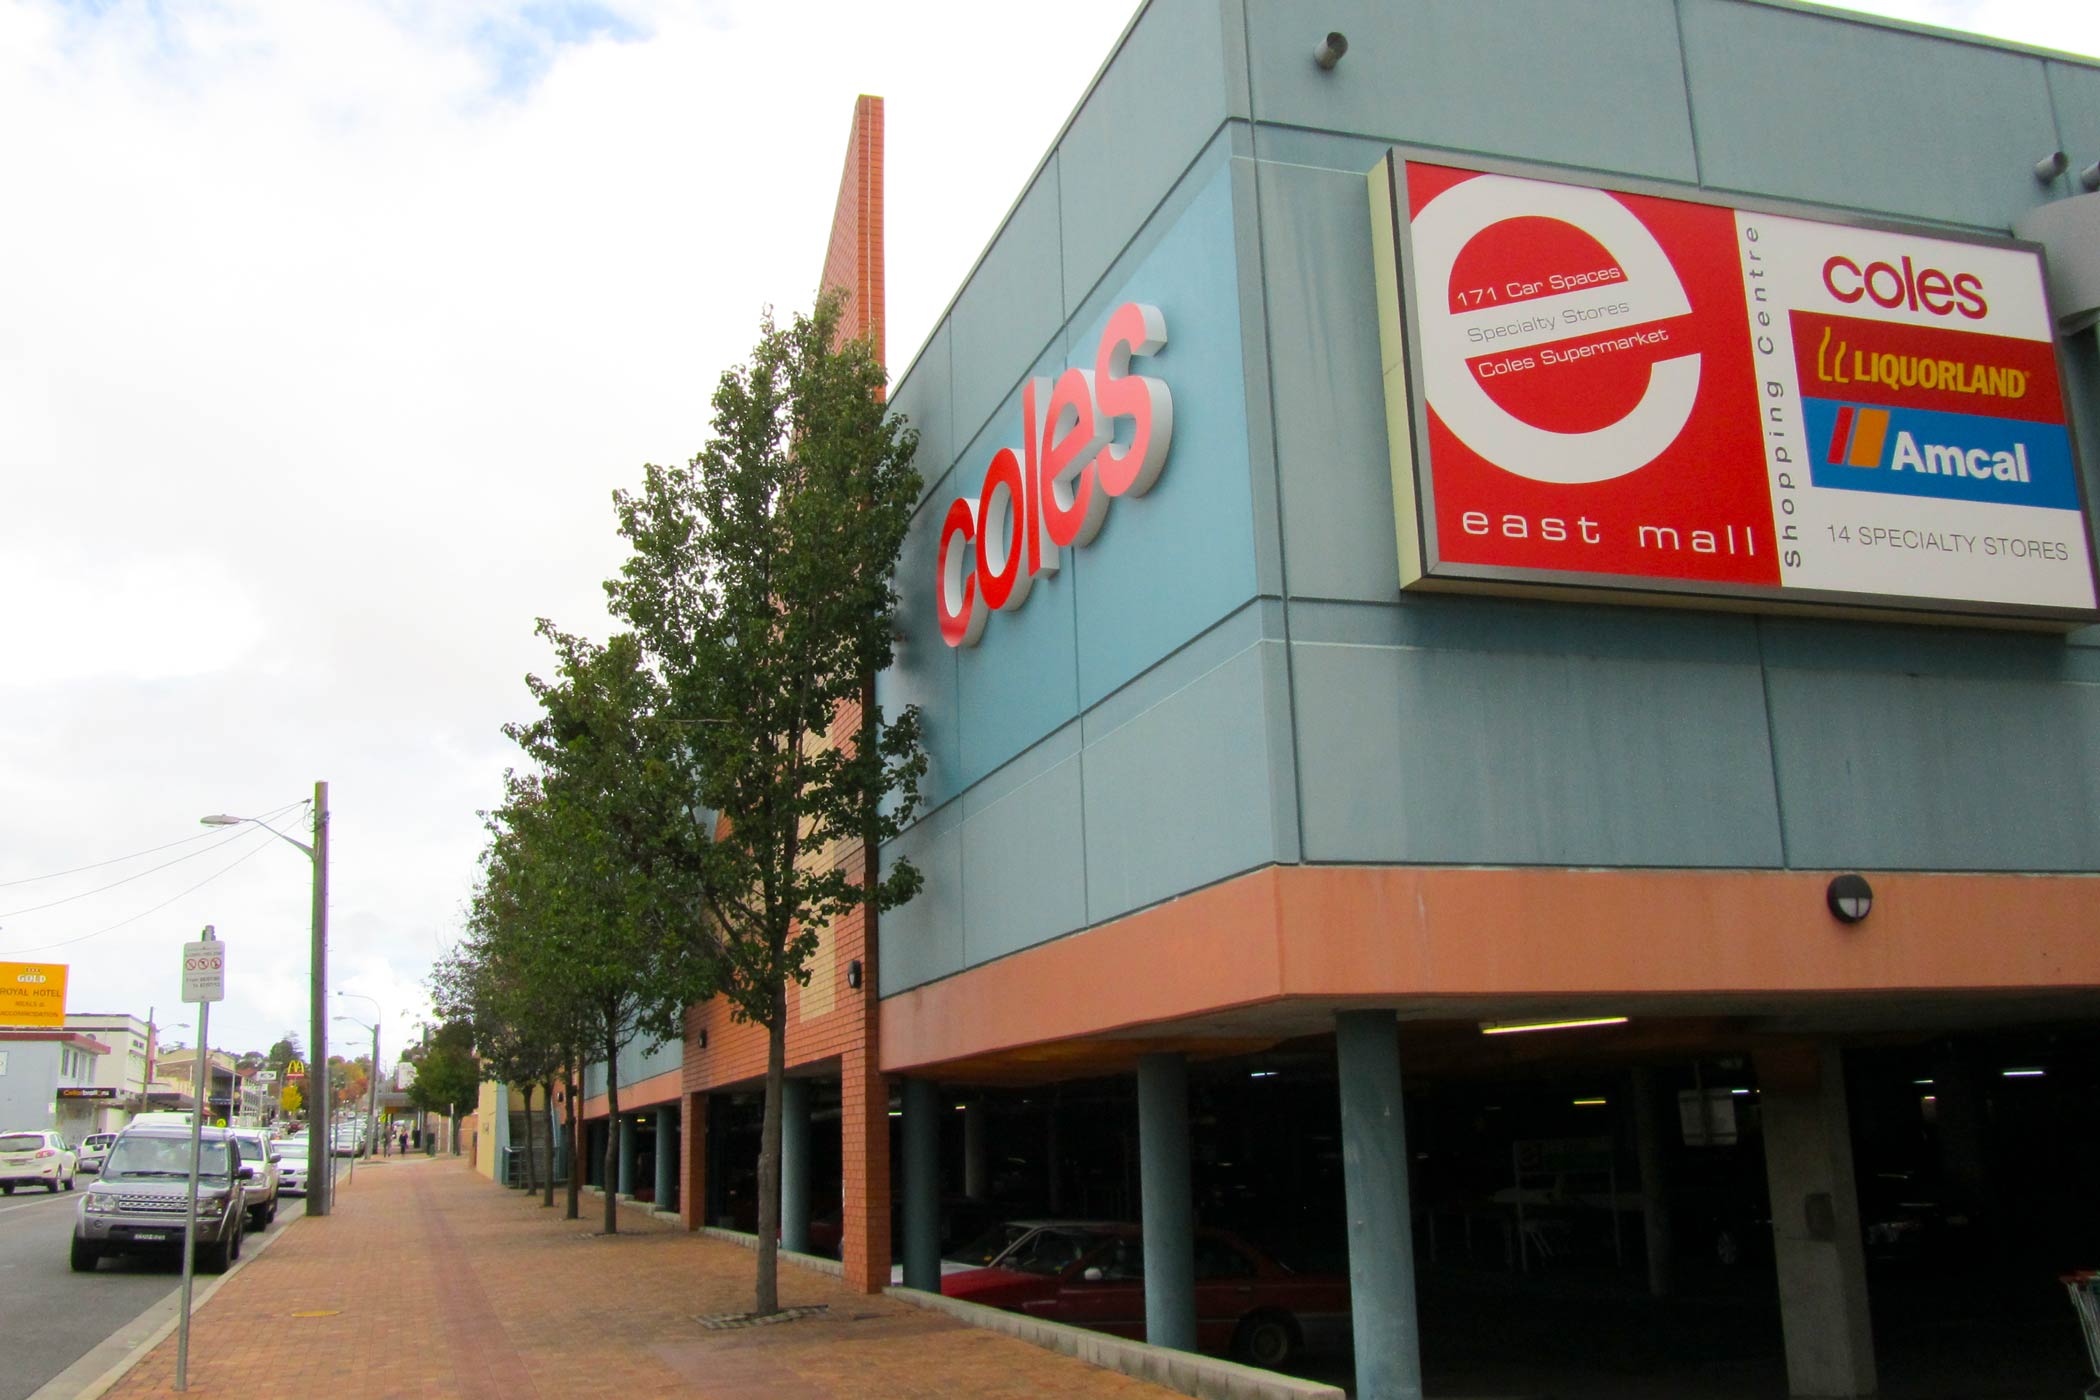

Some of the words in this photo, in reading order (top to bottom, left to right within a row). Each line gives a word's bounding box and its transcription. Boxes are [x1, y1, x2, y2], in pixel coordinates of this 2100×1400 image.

[1456, 286, 1498, 308] 171
[1506, 281, 1544, 298] Car
[1548, 266, 1622, 294] Spaces
[1745, 226, 1775, 355] Centre
[1822, 255, 1989, 320] coles
[1467, 312, 1556, 344] Specialty
[1563, 300, 1631, 325] Stores
[1478, 353, 1536, 379] Coles
[1542, 328, 1670, 368] Supermarket
[1854, 349, 2026, 399] LIQUORLAND
[936, 301, 1174, 648] coles
[1765, 380, 1801, 568] Shopping
[1890, 430, 2031, 484] Amcal
[1462, 510, 1602, 545] east
[1638, 524, 1756, 557] mall
[1826, 524, 1852, 544] 14
[1858, 526, 1978, 555] SPECIALTY
[1984, 536, 2069, 562] STORES
[0, 987, 29, 997] ROYAL
[32, 989, 62, 998] HOTEL
[17, 974, 47, 984] GOLD
